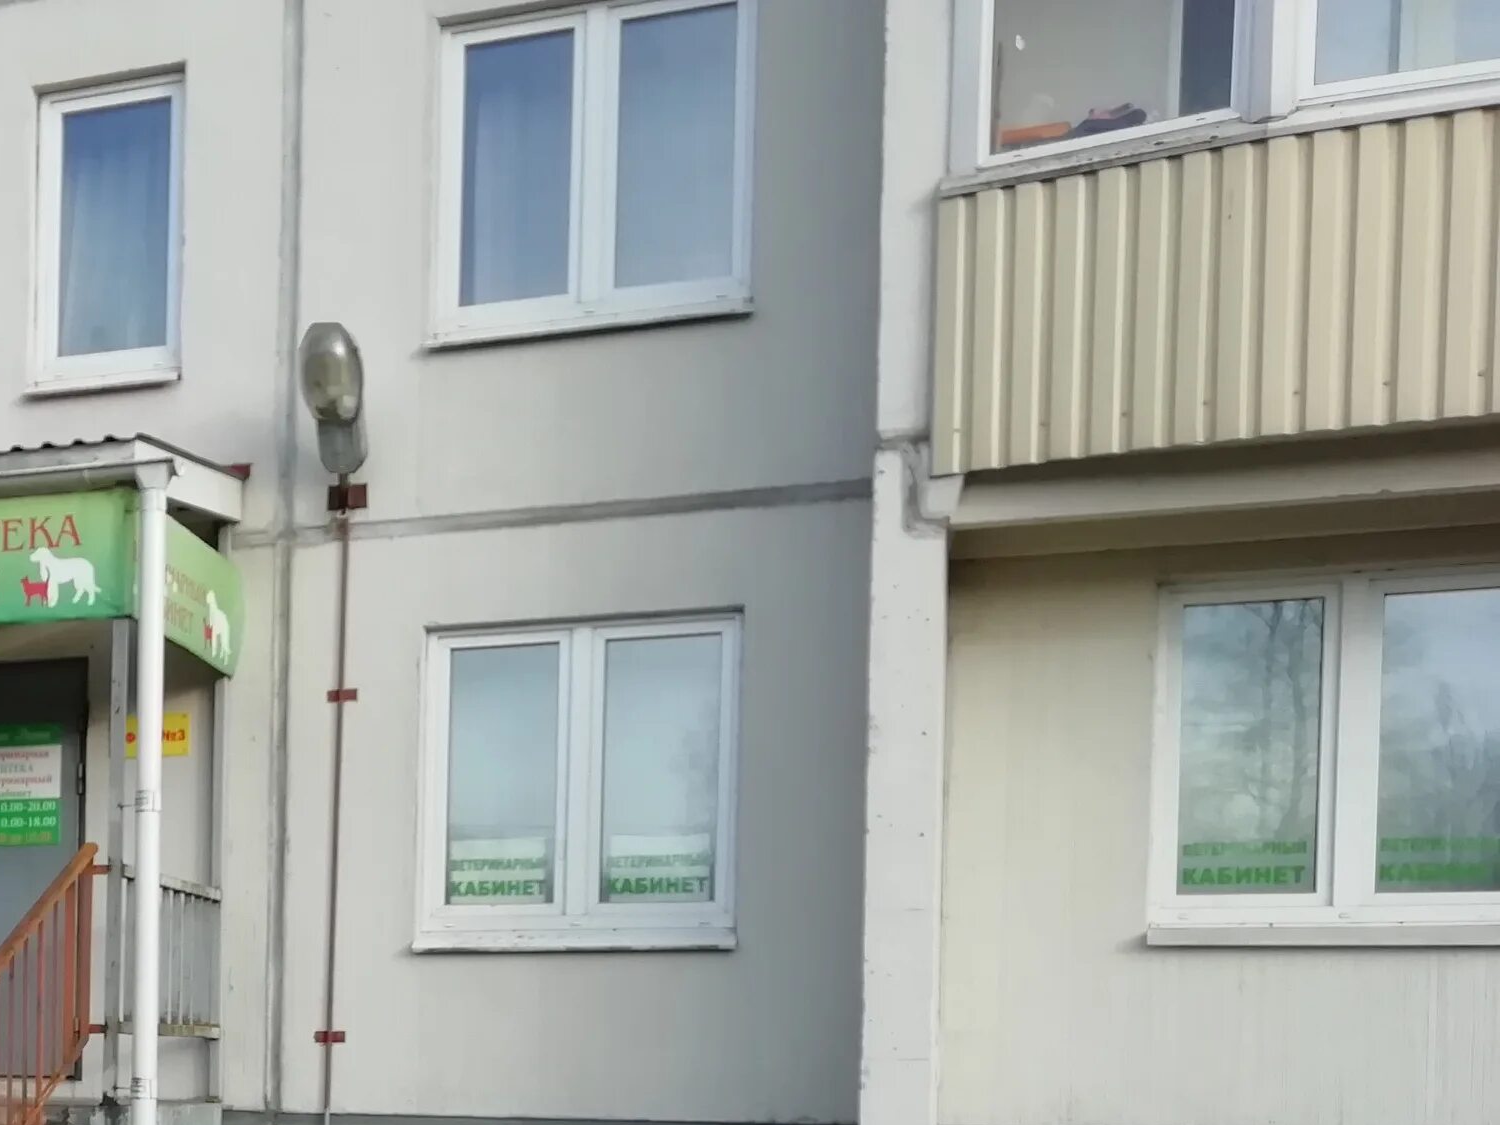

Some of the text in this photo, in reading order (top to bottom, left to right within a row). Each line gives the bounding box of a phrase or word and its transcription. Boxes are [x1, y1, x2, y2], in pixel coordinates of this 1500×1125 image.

[1182, 865, 1306, 885] КАБИНЕТ
[450, 880, 544, 896] КАБИНЕТ
[607, 876, 709, 895] КАБИНЕТ
